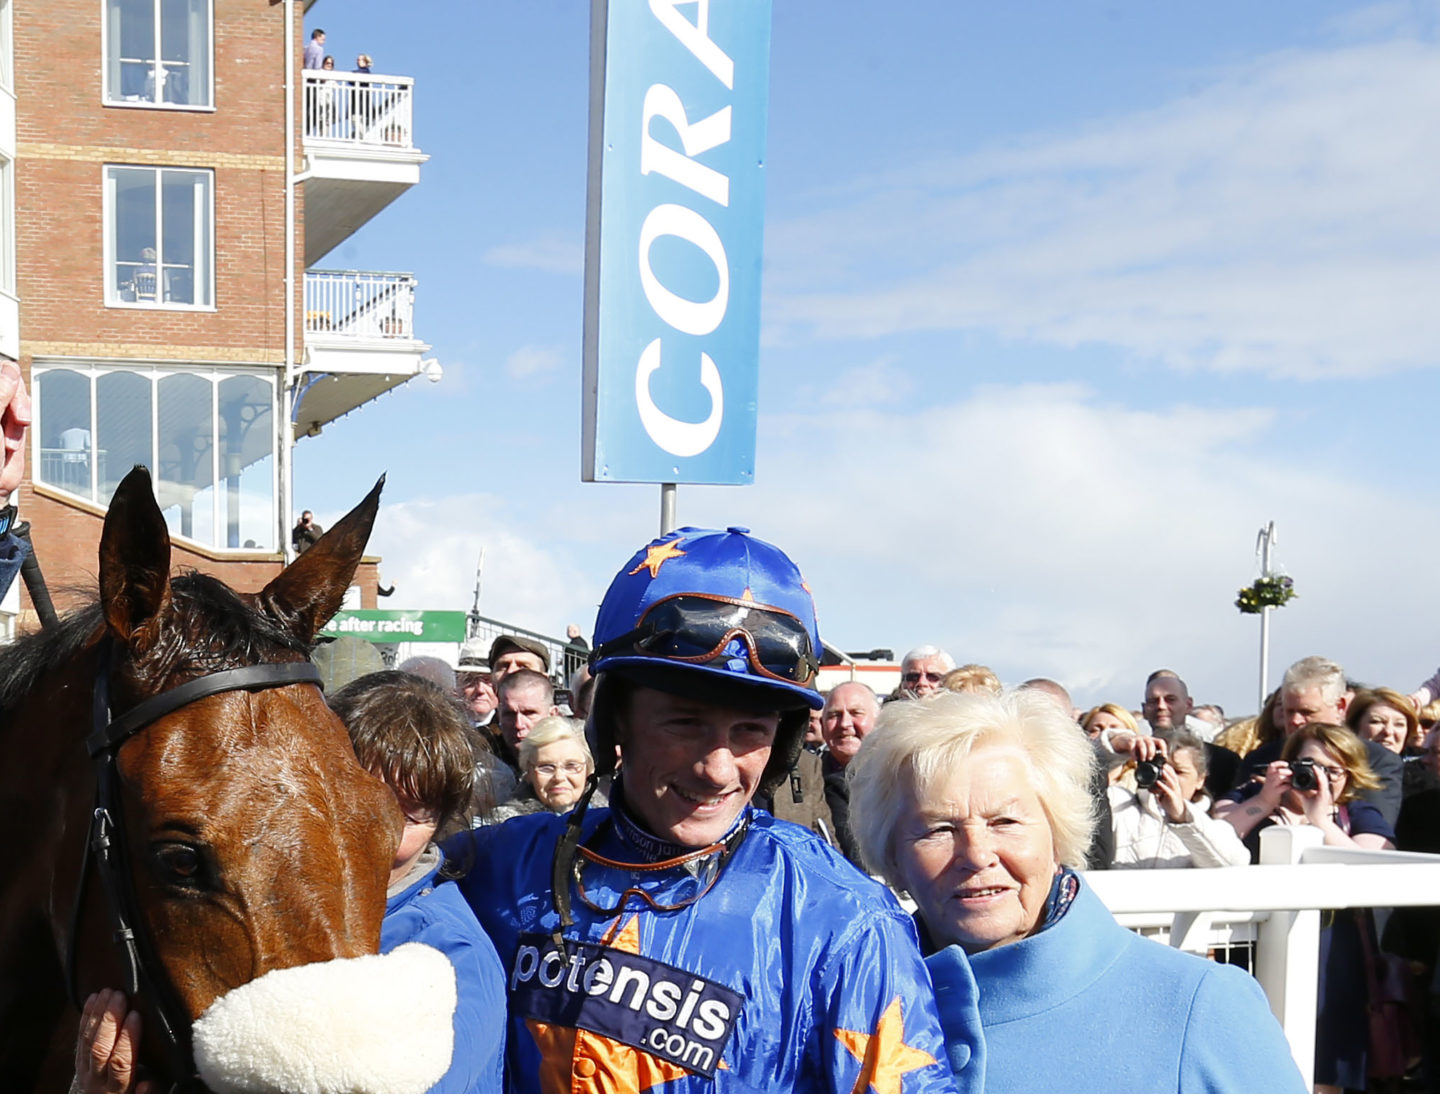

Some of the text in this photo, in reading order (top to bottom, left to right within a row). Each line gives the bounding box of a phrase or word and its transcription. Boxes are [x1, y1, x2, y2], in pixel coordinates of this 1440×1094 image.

[339, 616, 376, 632] after
[377, 616, 424, 635] racing
[512, 945, 730, 1040] potensis
[640, 1028, 714, 1071] .com
